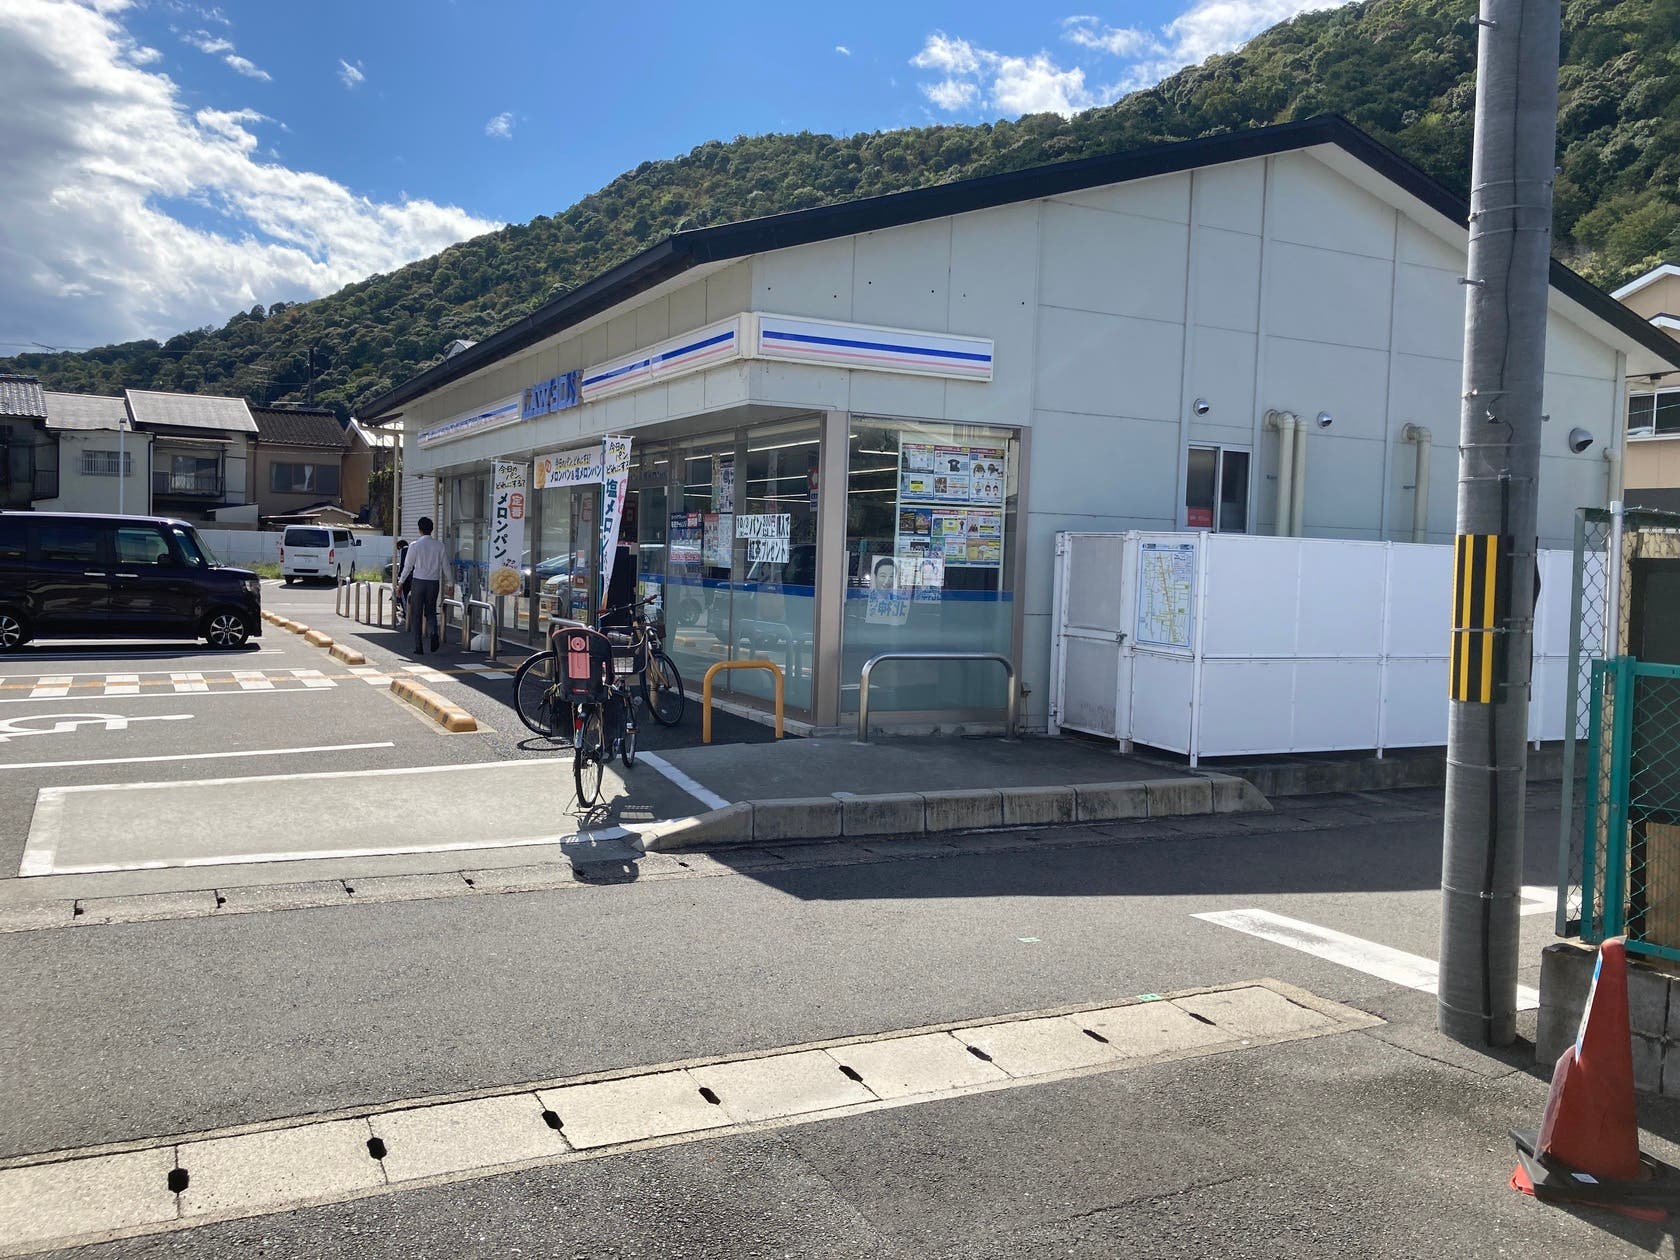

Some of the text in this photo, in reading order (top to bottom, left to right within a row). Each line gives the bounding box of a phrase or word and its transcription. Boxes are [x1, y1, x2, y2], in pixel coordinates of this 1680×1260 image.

[521, 369, 582, 420] LAWSON
[493, 493, 508, 559] メロンパン
[749, 515, 762, 537] パン
